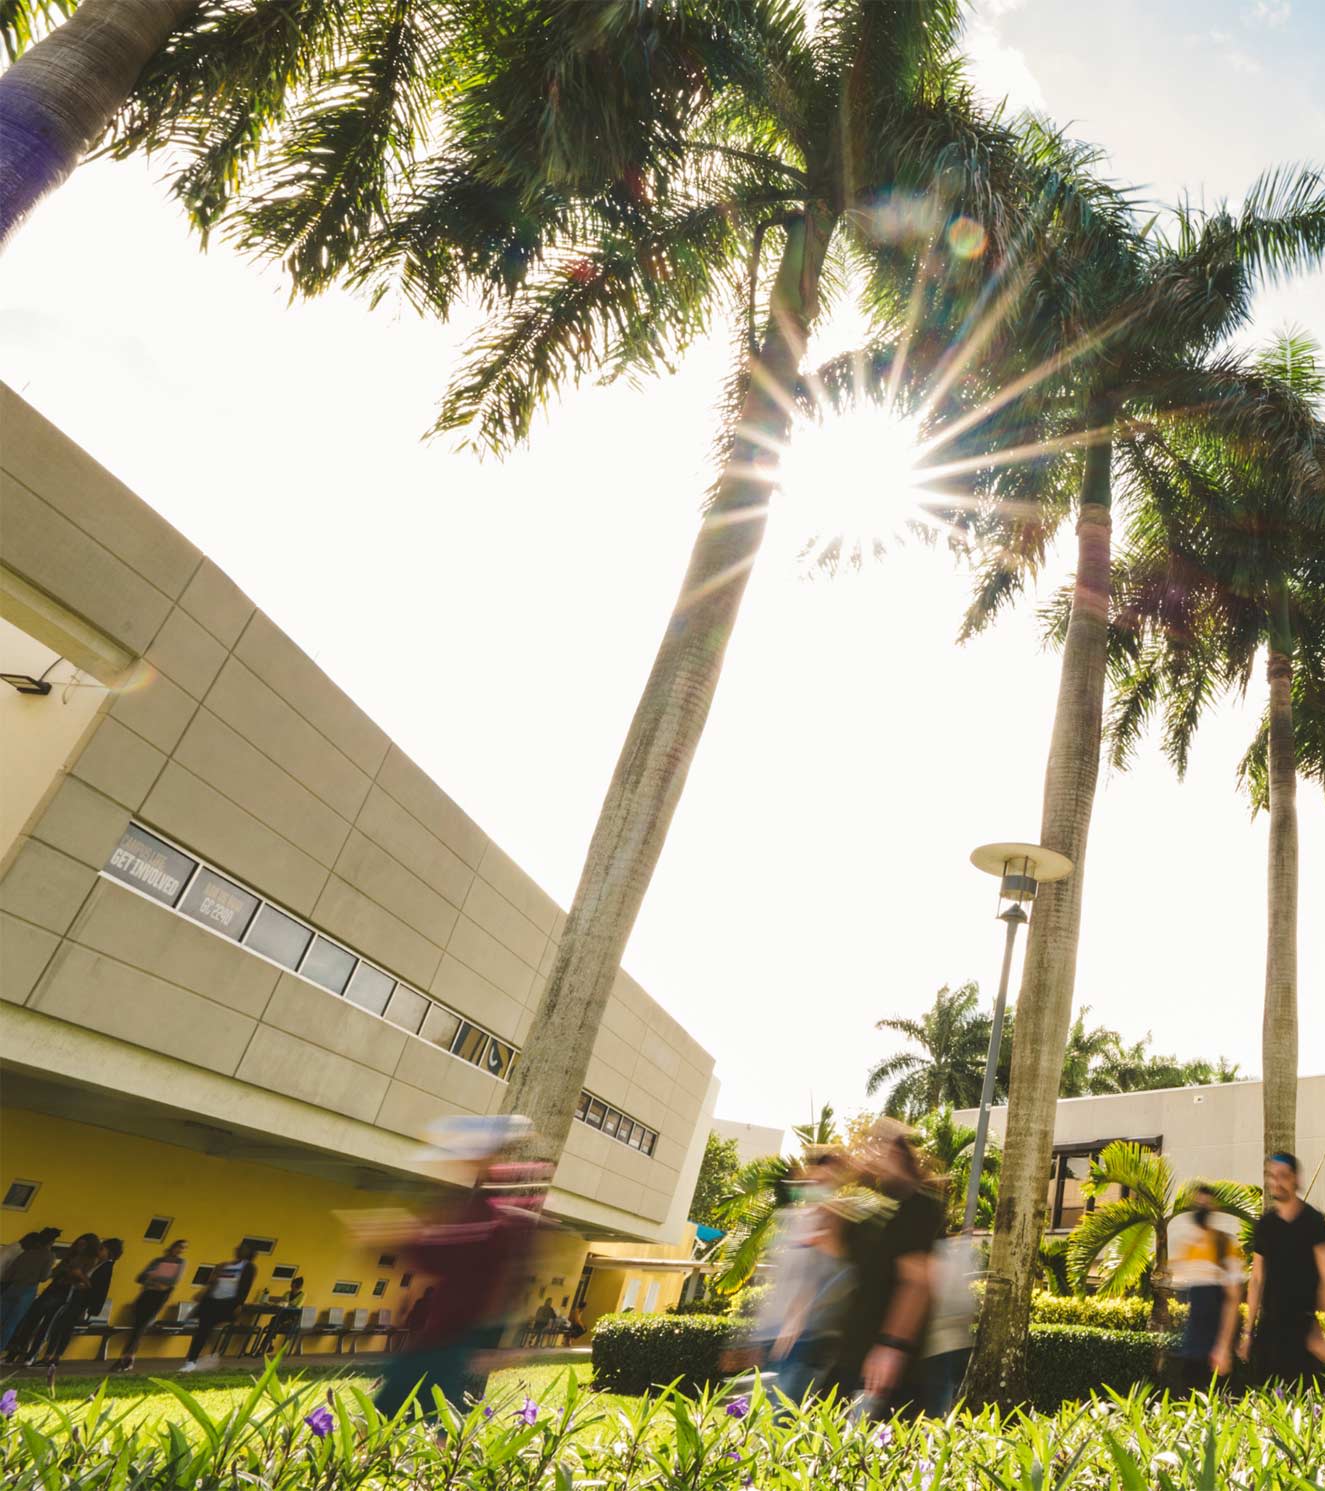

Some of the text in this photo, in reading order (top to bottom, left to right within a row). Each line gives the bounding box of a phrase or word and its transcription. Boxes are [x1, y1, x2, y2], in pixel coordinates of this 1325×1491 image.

[110, 847, 180, 896] GET INVOLVED
[200, 897, 215, 915] GC
